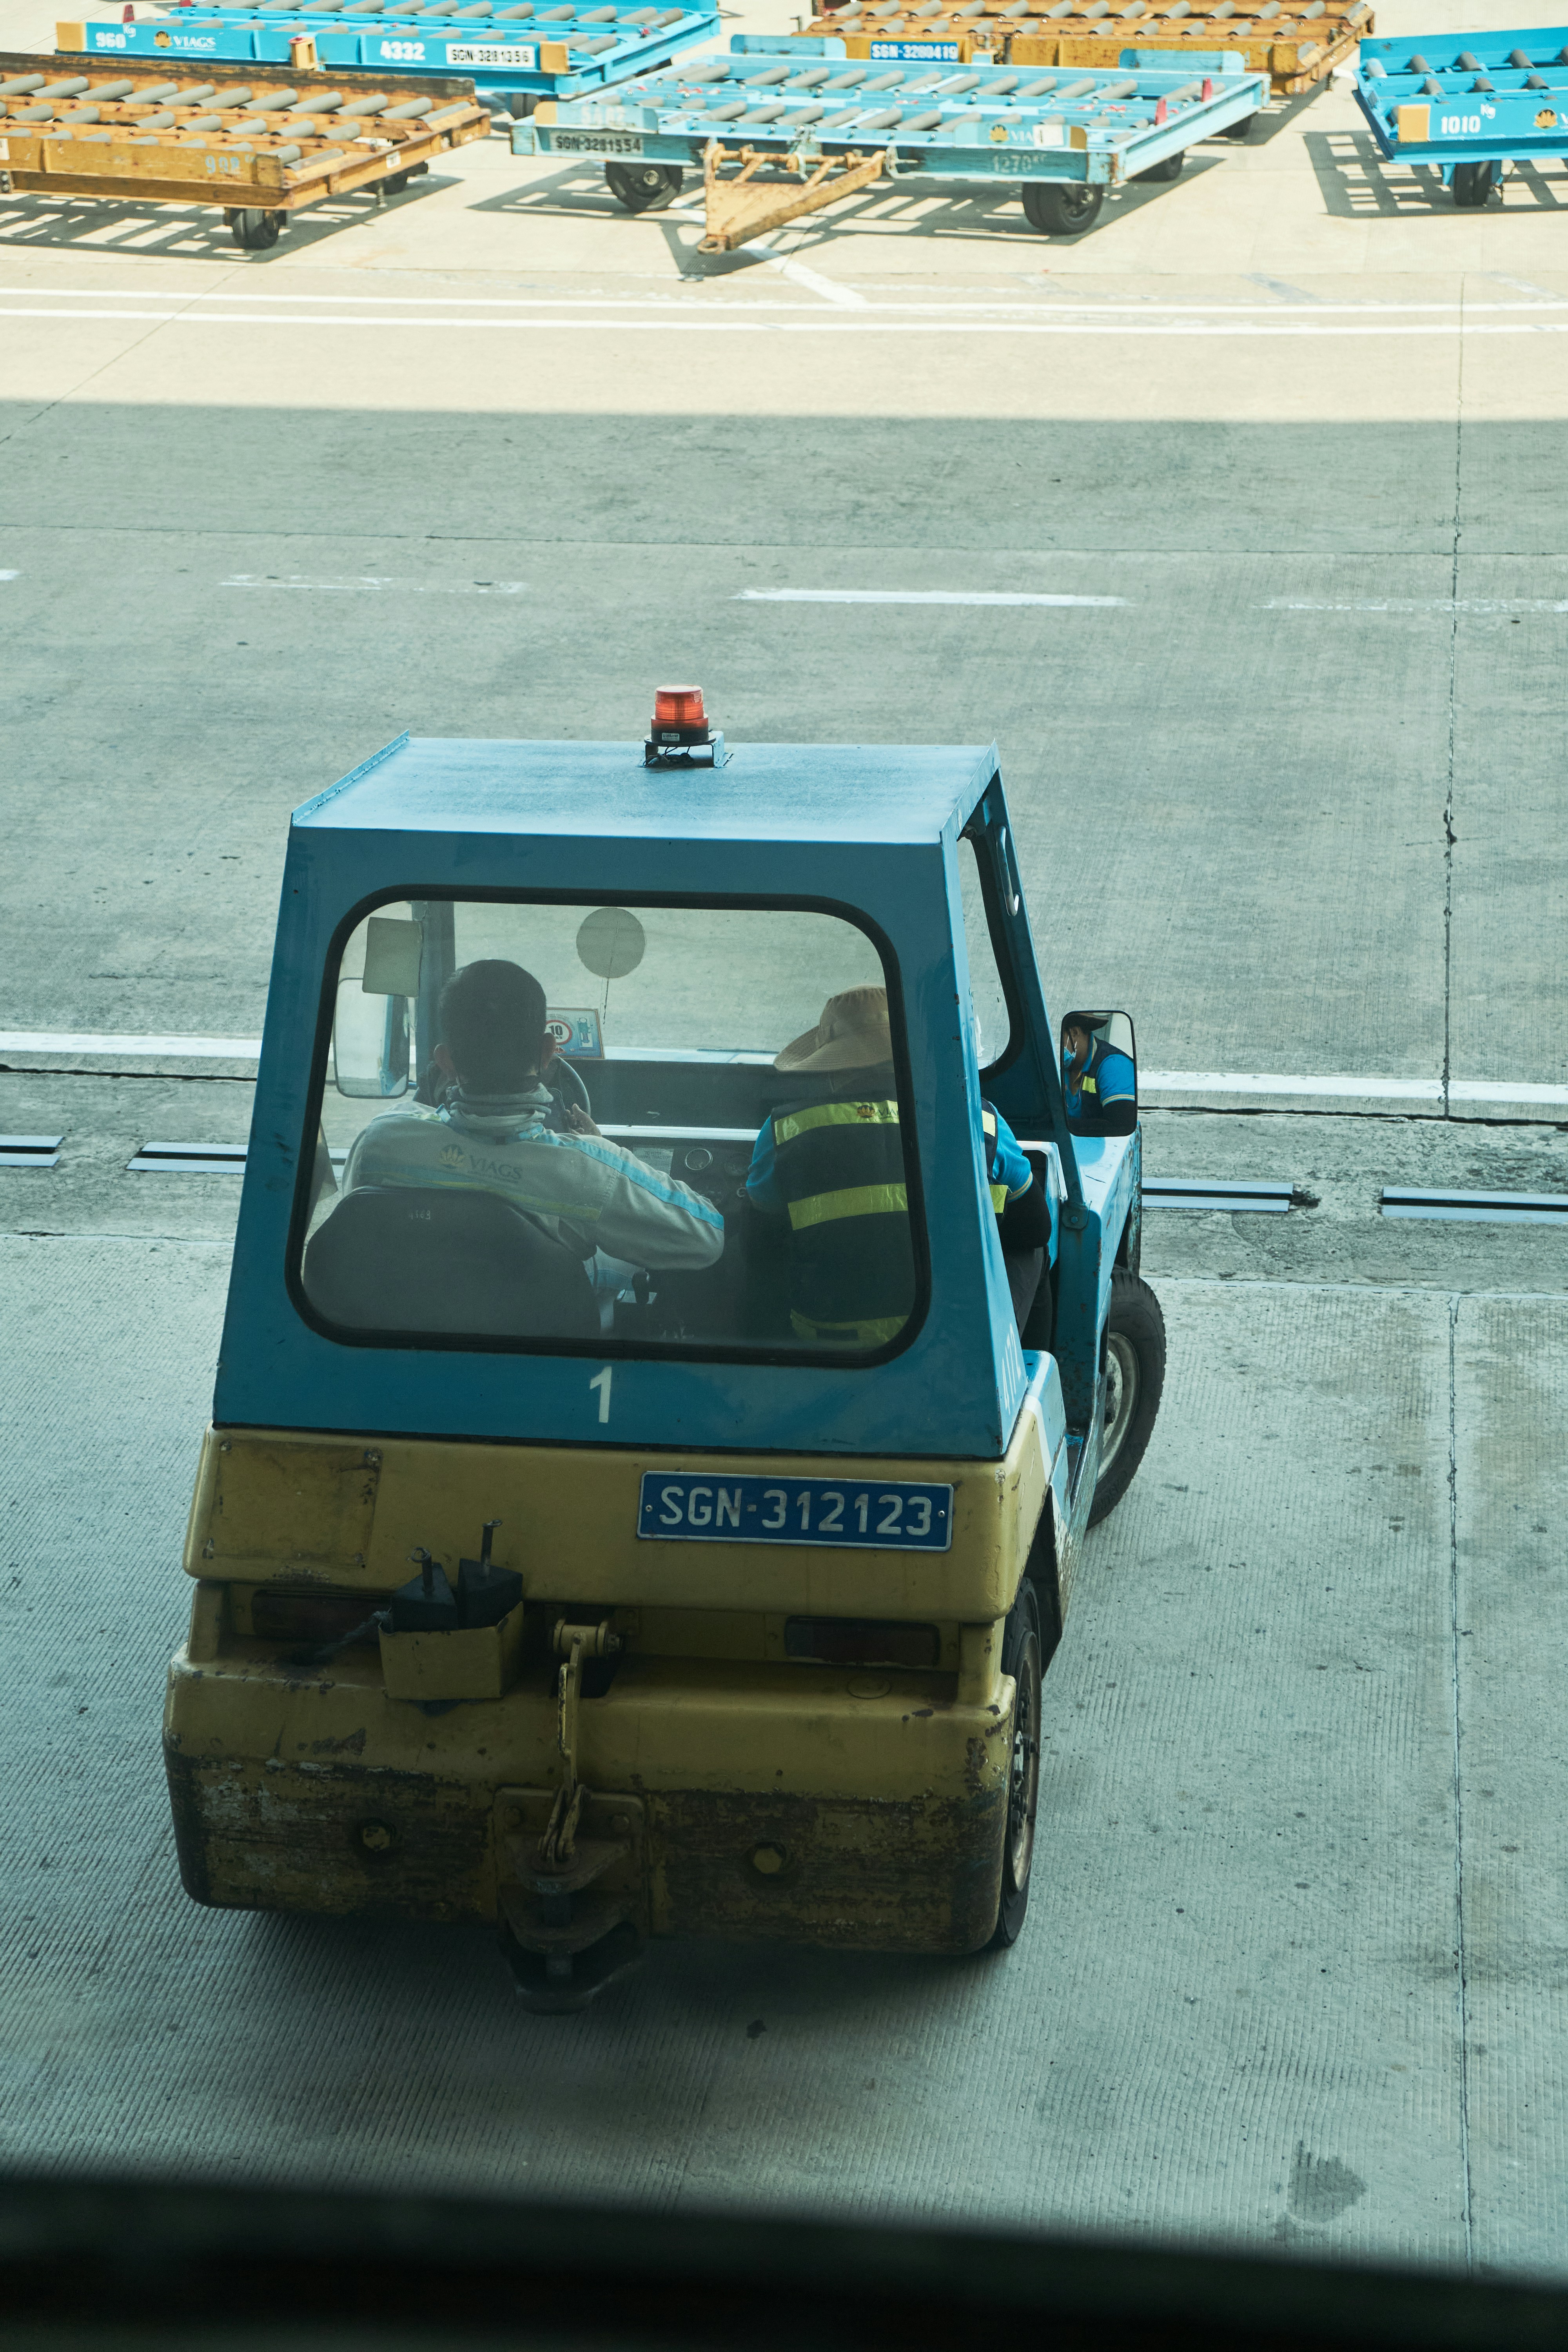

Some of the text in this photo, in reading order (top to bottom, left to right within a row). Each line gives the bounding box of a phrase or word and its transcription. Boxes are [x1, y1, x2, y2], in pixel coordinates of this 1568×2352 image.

[96, 32, 127, 49] 960
[173, 36, 216, 48] VIAGS
[380, 40, 425, 60] 4332
[1441, 103, 1496, 134] 1010 Kg
[549, 1025, 563, 1036] 10
[468, 1155, 523, 1180] VIAGS
[589, 1367, 612, 1423] 1
[659, 1486, 932, 1536] SGN-312123
